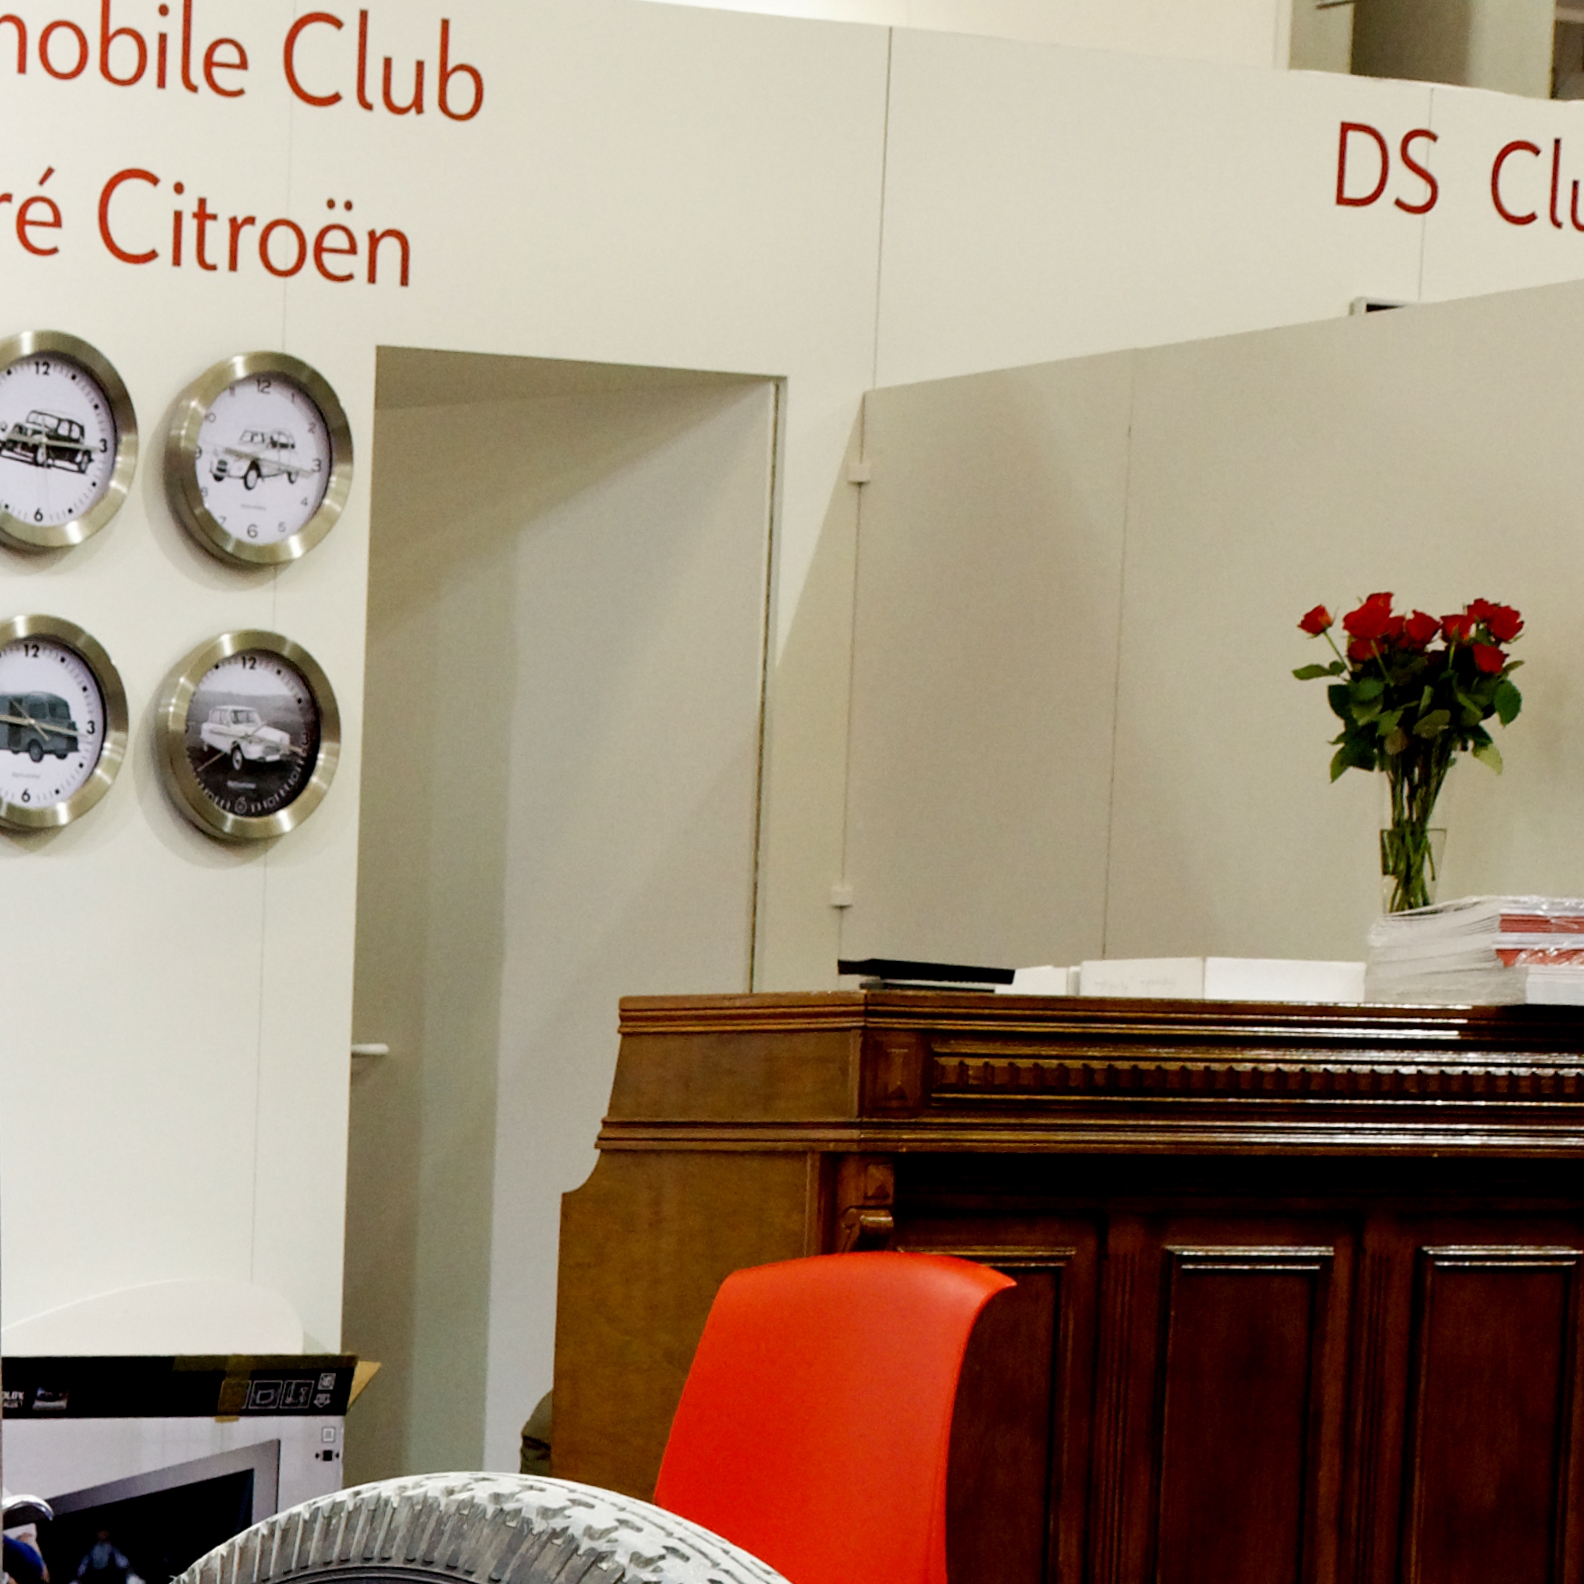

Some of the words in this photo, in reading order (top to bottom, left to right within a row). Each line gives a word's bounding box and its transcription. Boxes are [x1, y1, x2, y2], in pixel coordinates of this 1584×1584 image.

[283, 9, 484, 122] Club
[1335, 121, 1439, 215] DS
[98, 168, 410, 287] Citroën
[34, 361, 51, 375] 12
[34, 508, 43, 522] 6
